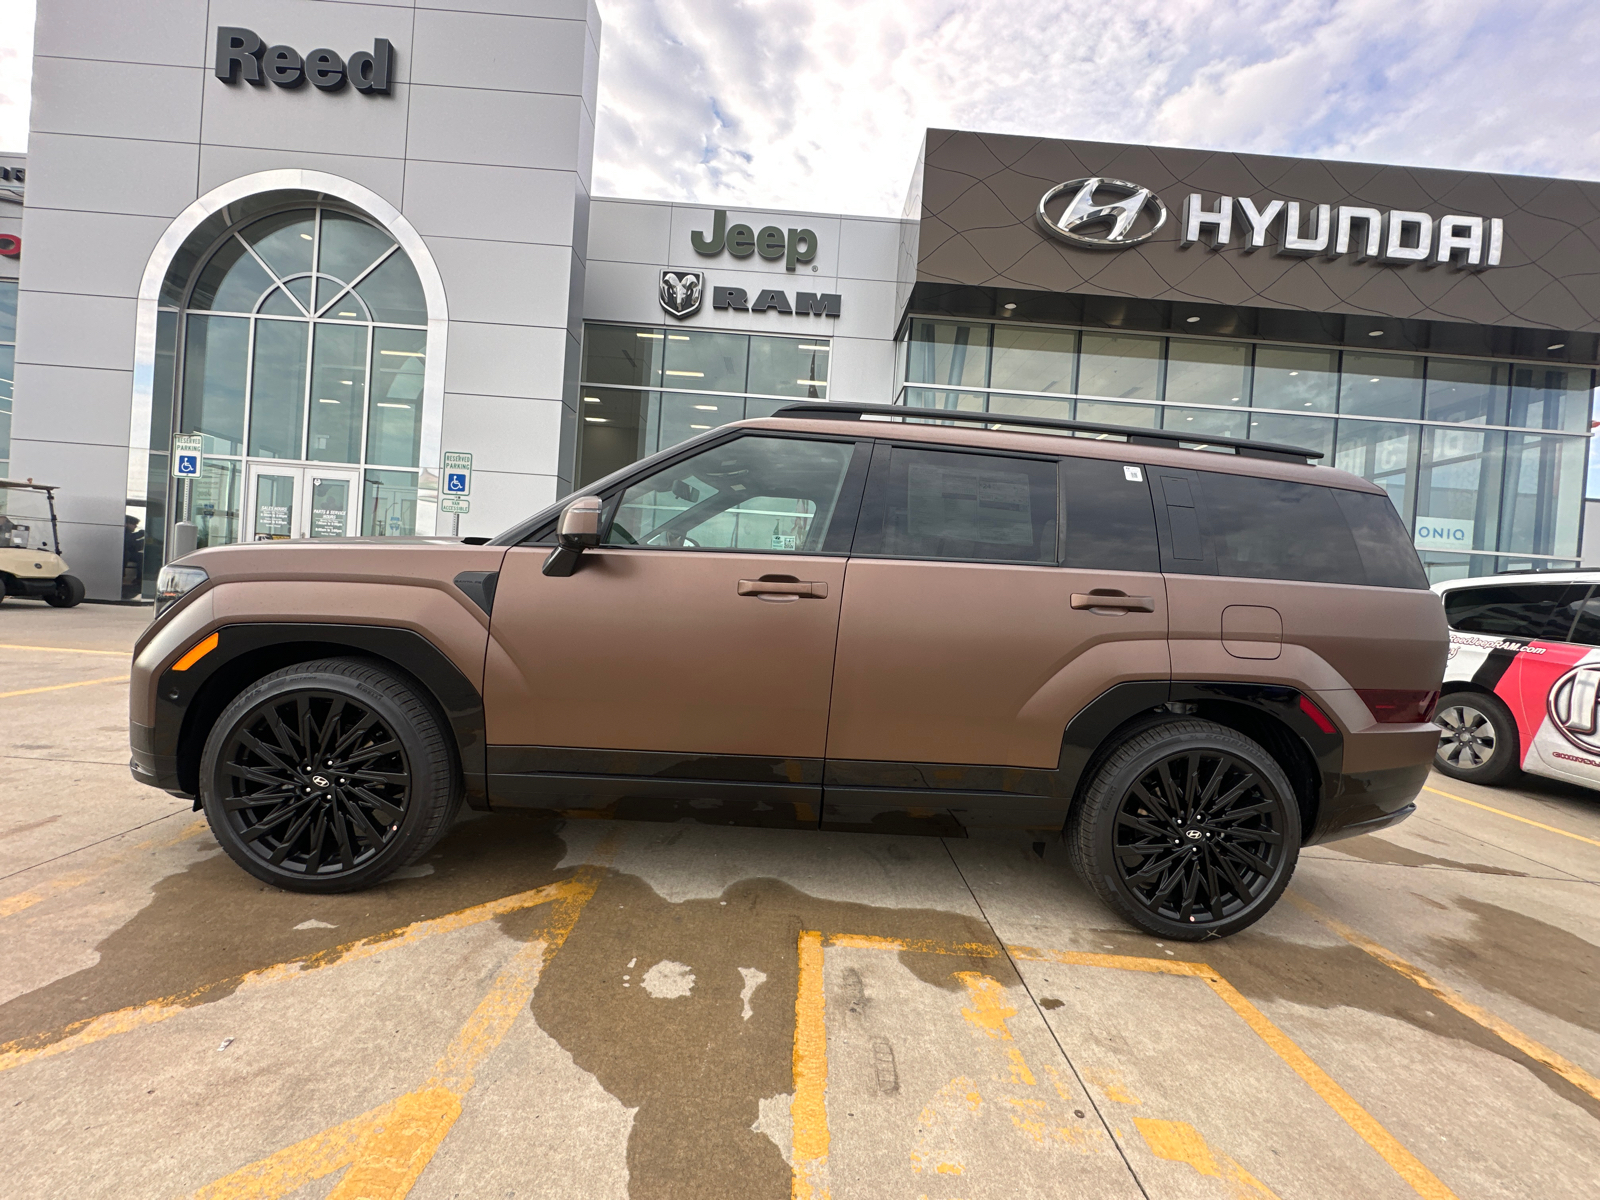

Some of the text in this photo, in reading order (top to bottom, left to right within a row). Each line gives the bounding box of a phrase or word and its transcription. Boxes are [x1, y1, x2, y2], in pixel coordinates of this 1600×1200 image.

[215, 26, 393, 94] Reed
[691, 210, 818, 271] Jeep
[1183, 193, 1504, 267] HYUNDAI
[713, 286, 842, 318] RAM
[177, 437, 201, 445] RESERVED
[446, 455, 470, 463] RESERVED
[1418, 526, 1465, 541] ONIQ
[1552, 751, 1600, 768] CHRYSL
